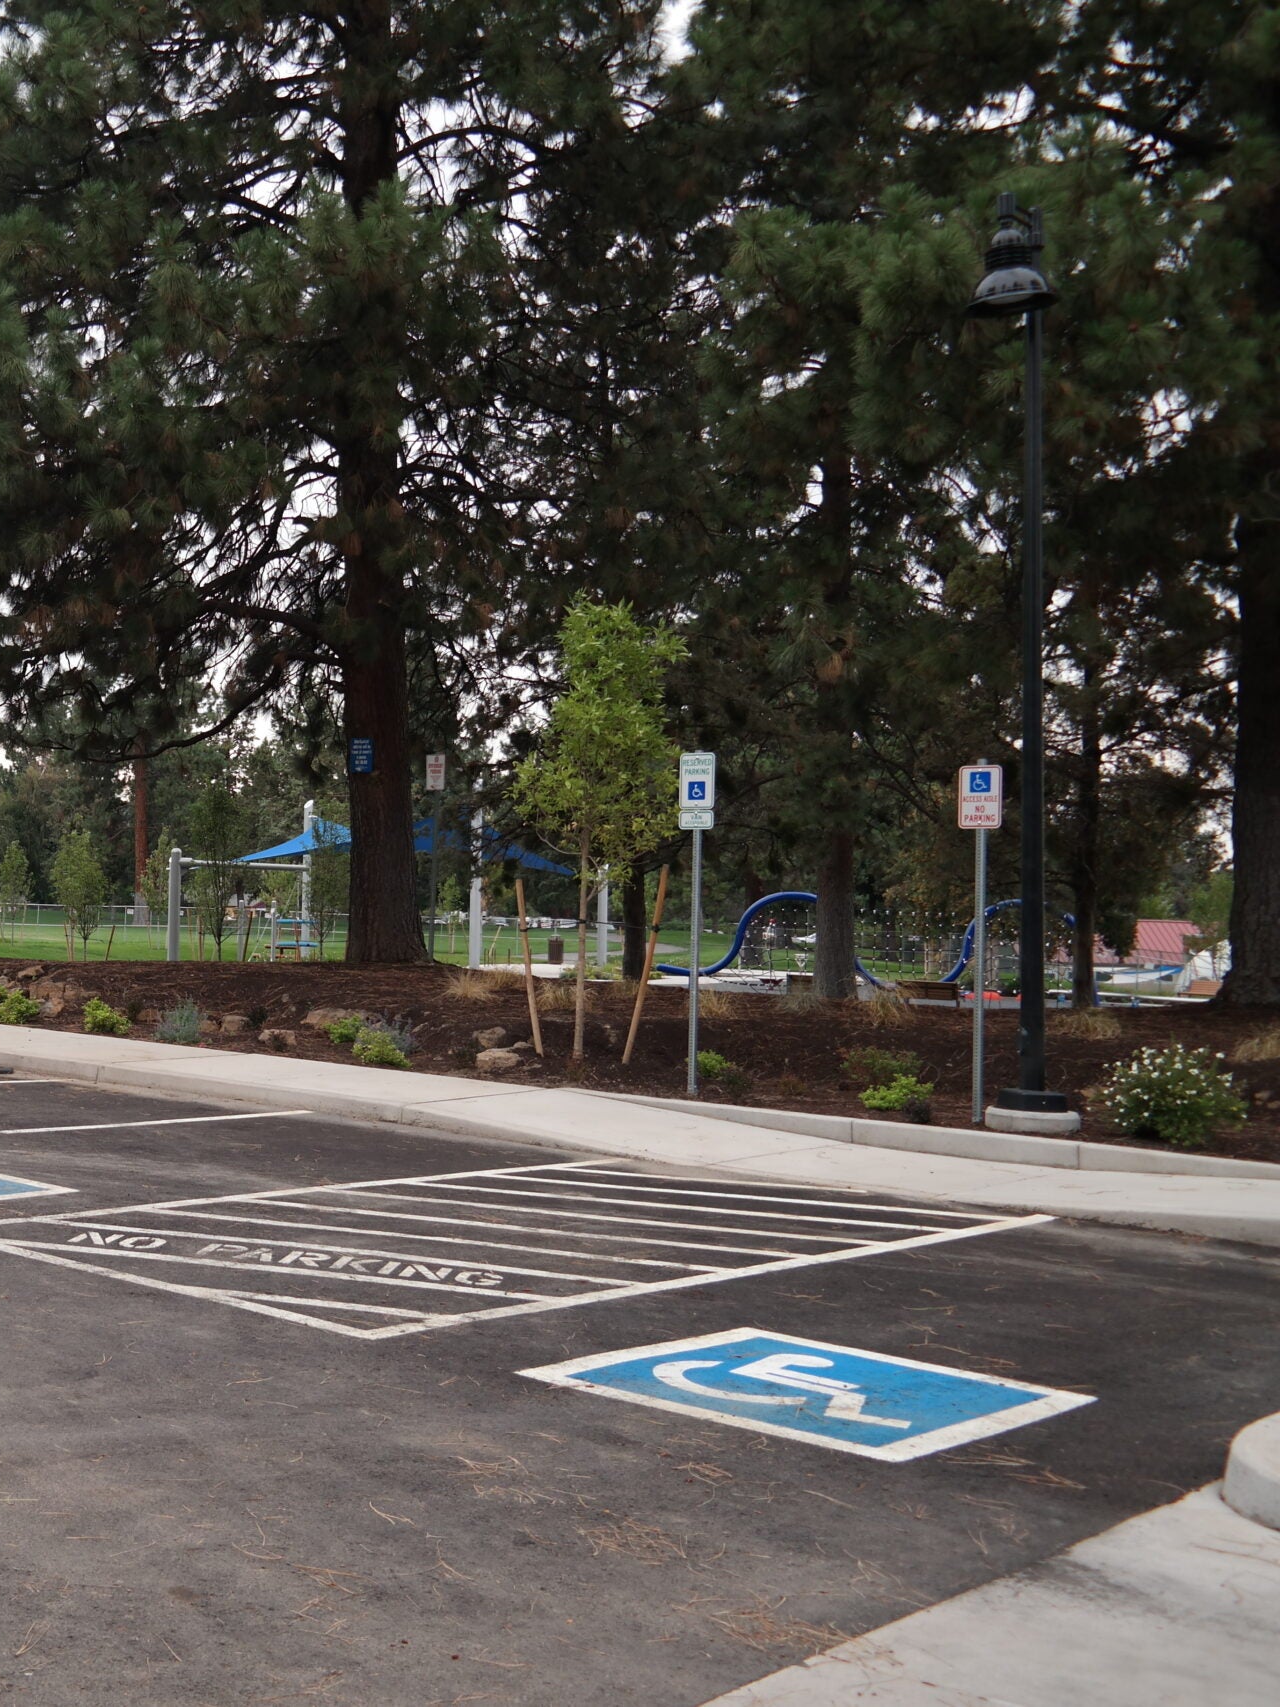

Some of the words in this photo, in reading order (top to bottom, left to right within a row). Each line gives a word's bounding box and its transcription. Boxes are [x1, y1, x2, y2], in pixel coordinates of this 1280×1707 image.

[682, 759, 712, 767] RESERVED
[684, 767, 710, 776] PARKING
[963, 795, 982, 803] ACCESS
[975, 805, 985, 813] NO
[964, 814, 996, 823] PARKING
[67, 1231, 168, 1249] NO
[195, 1242, 504, 1287] PARKING
